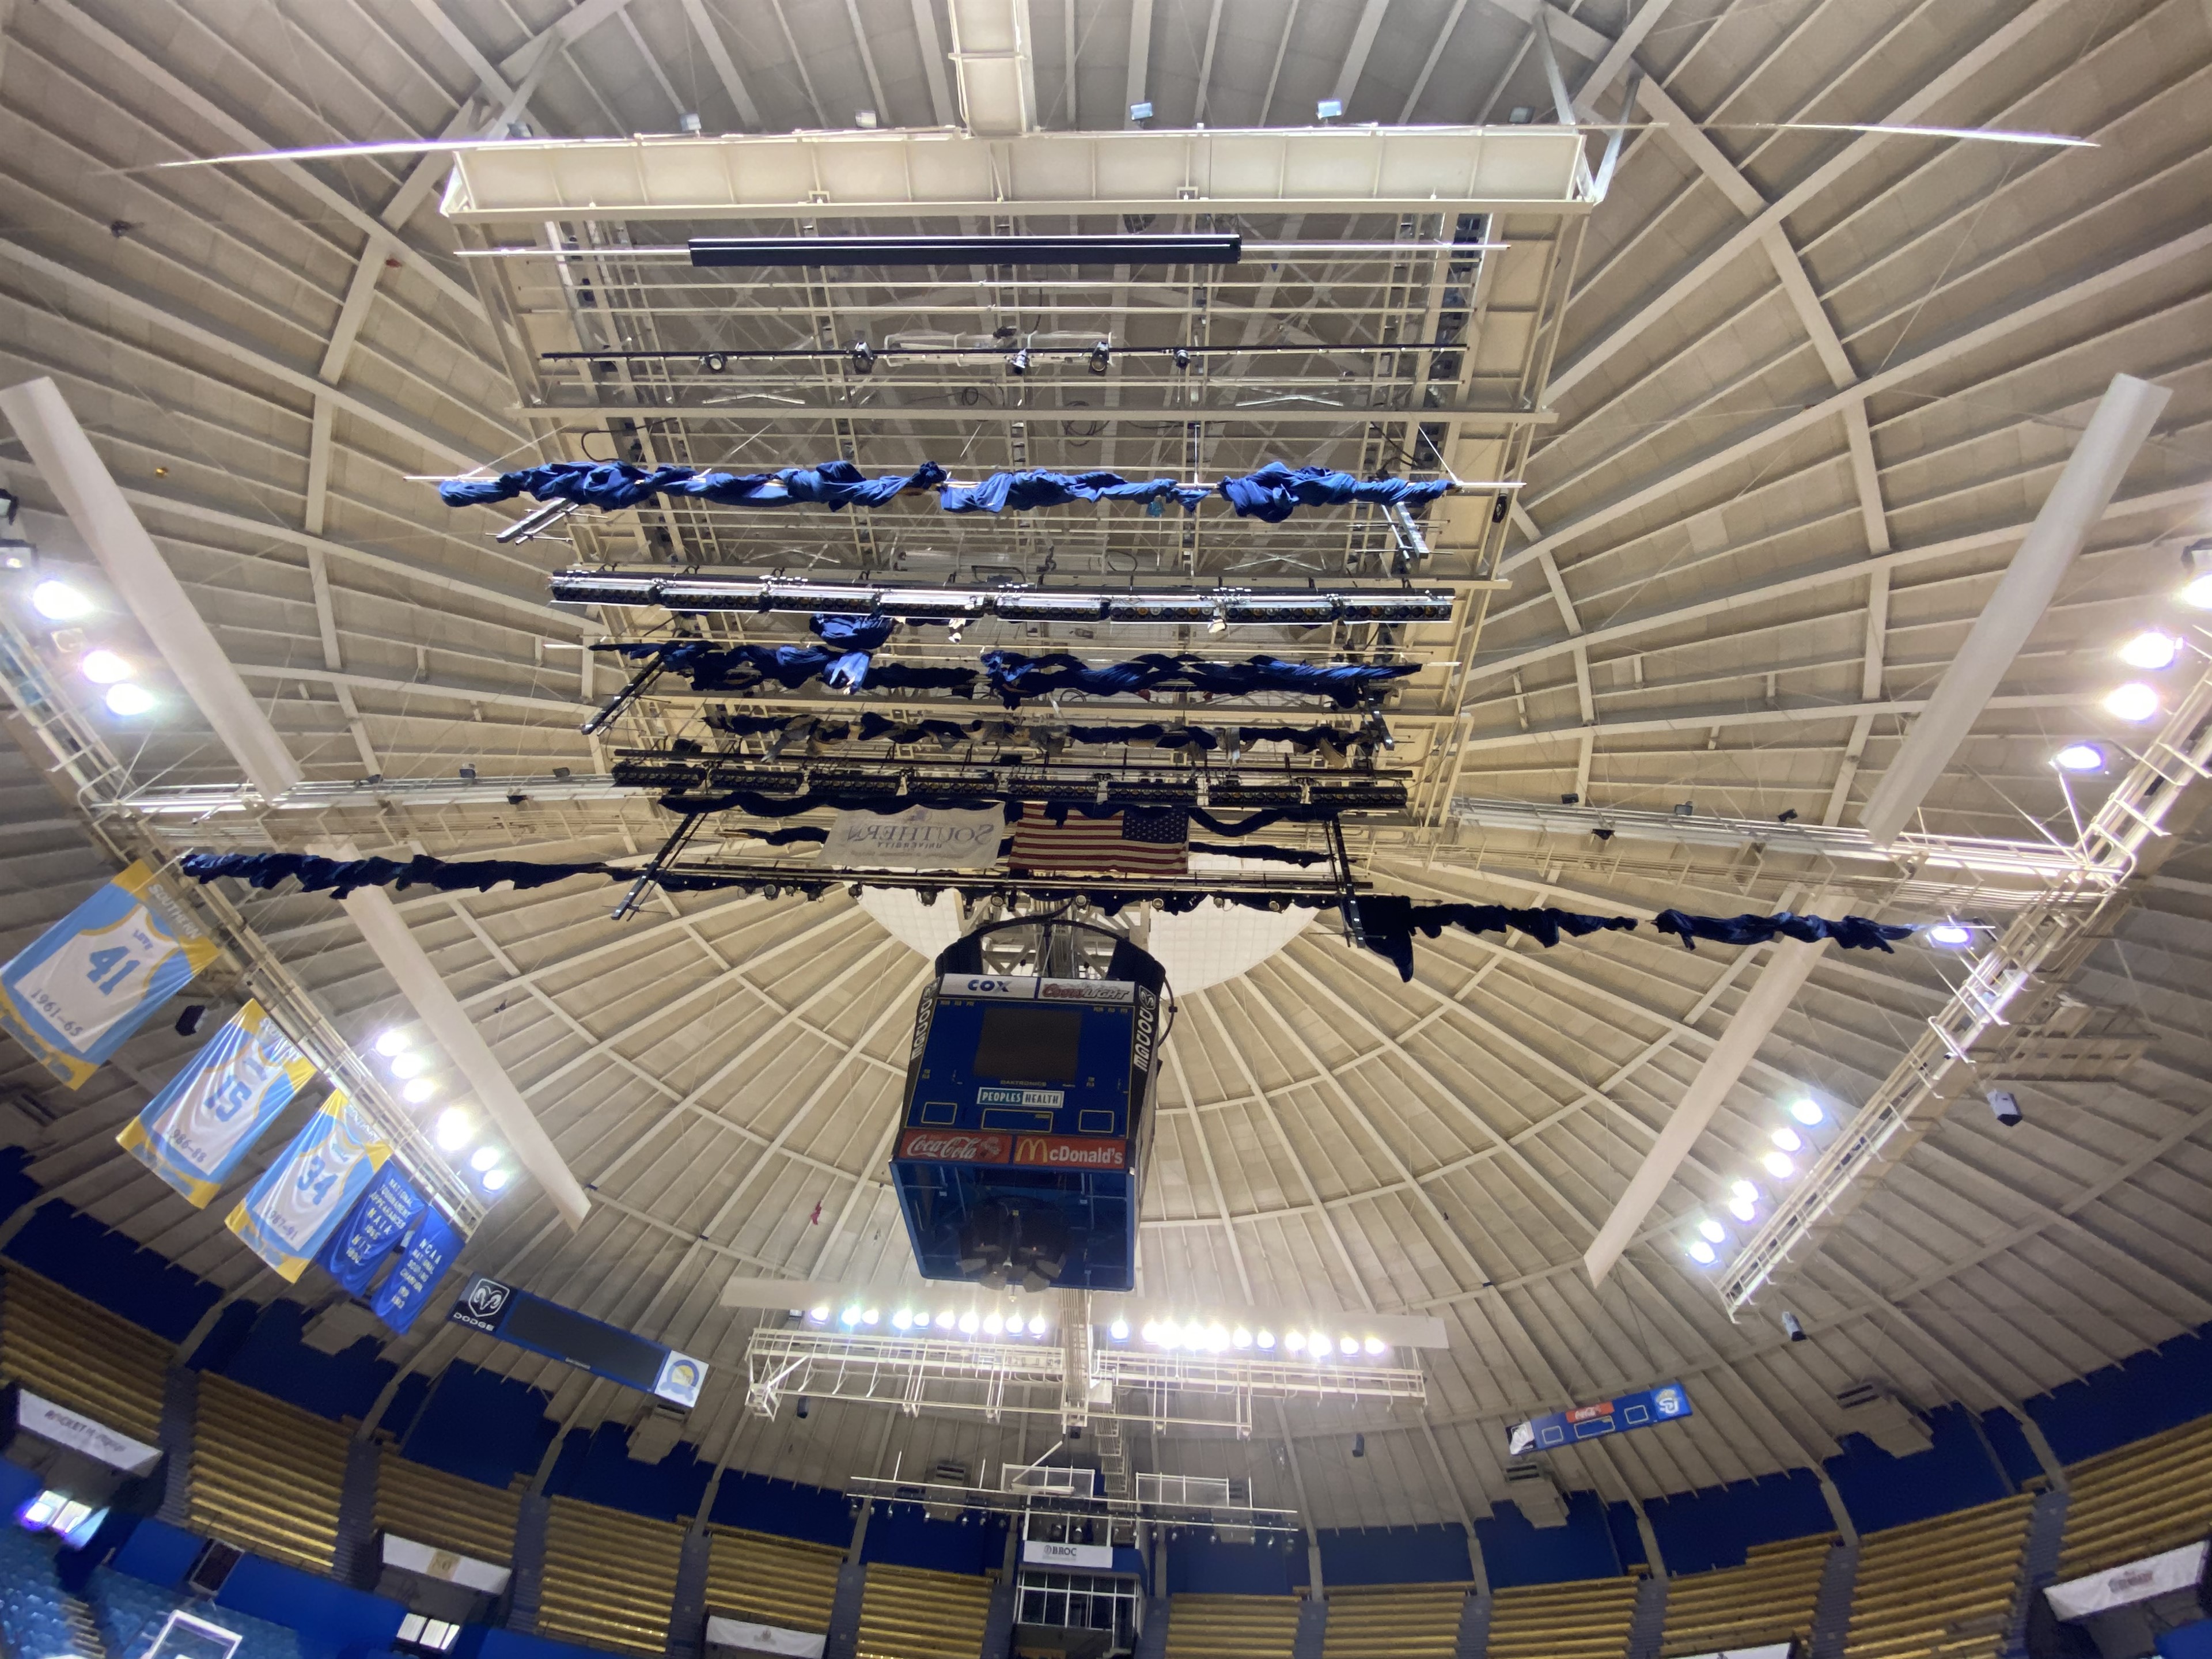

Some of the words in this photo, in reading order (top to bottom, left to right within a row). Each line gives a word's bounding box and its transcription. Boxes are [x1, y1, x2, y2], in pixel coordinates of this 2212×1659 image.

[147, 884, 202, 941] SOUTHERN
[86, 946, 141, 996] 41
[968, 979, 1013, 993] COX
[1042, 983, 1085, 998] Coors
[1083, 988, 1130, 1001] LIGHT
[910, 998, 933, 1060] DODGE
[1133, 1006, 1154, 1072] DODGE
[981, 1091, 1021, 1103] PEOPLES
[1025, 1093, 1059, 1105] HEALTH
[907, 1134, 980, 1160] Coca-Cola
[1015, 1138, 1123, 1165] McDonald's
[297, 1156, 339, 1205] 34
[412, 1248, 435, 1275] NATONAL
[419, 1238, 442, 1265] NCAA
[453, 1311, 495, 1332] DODGE
